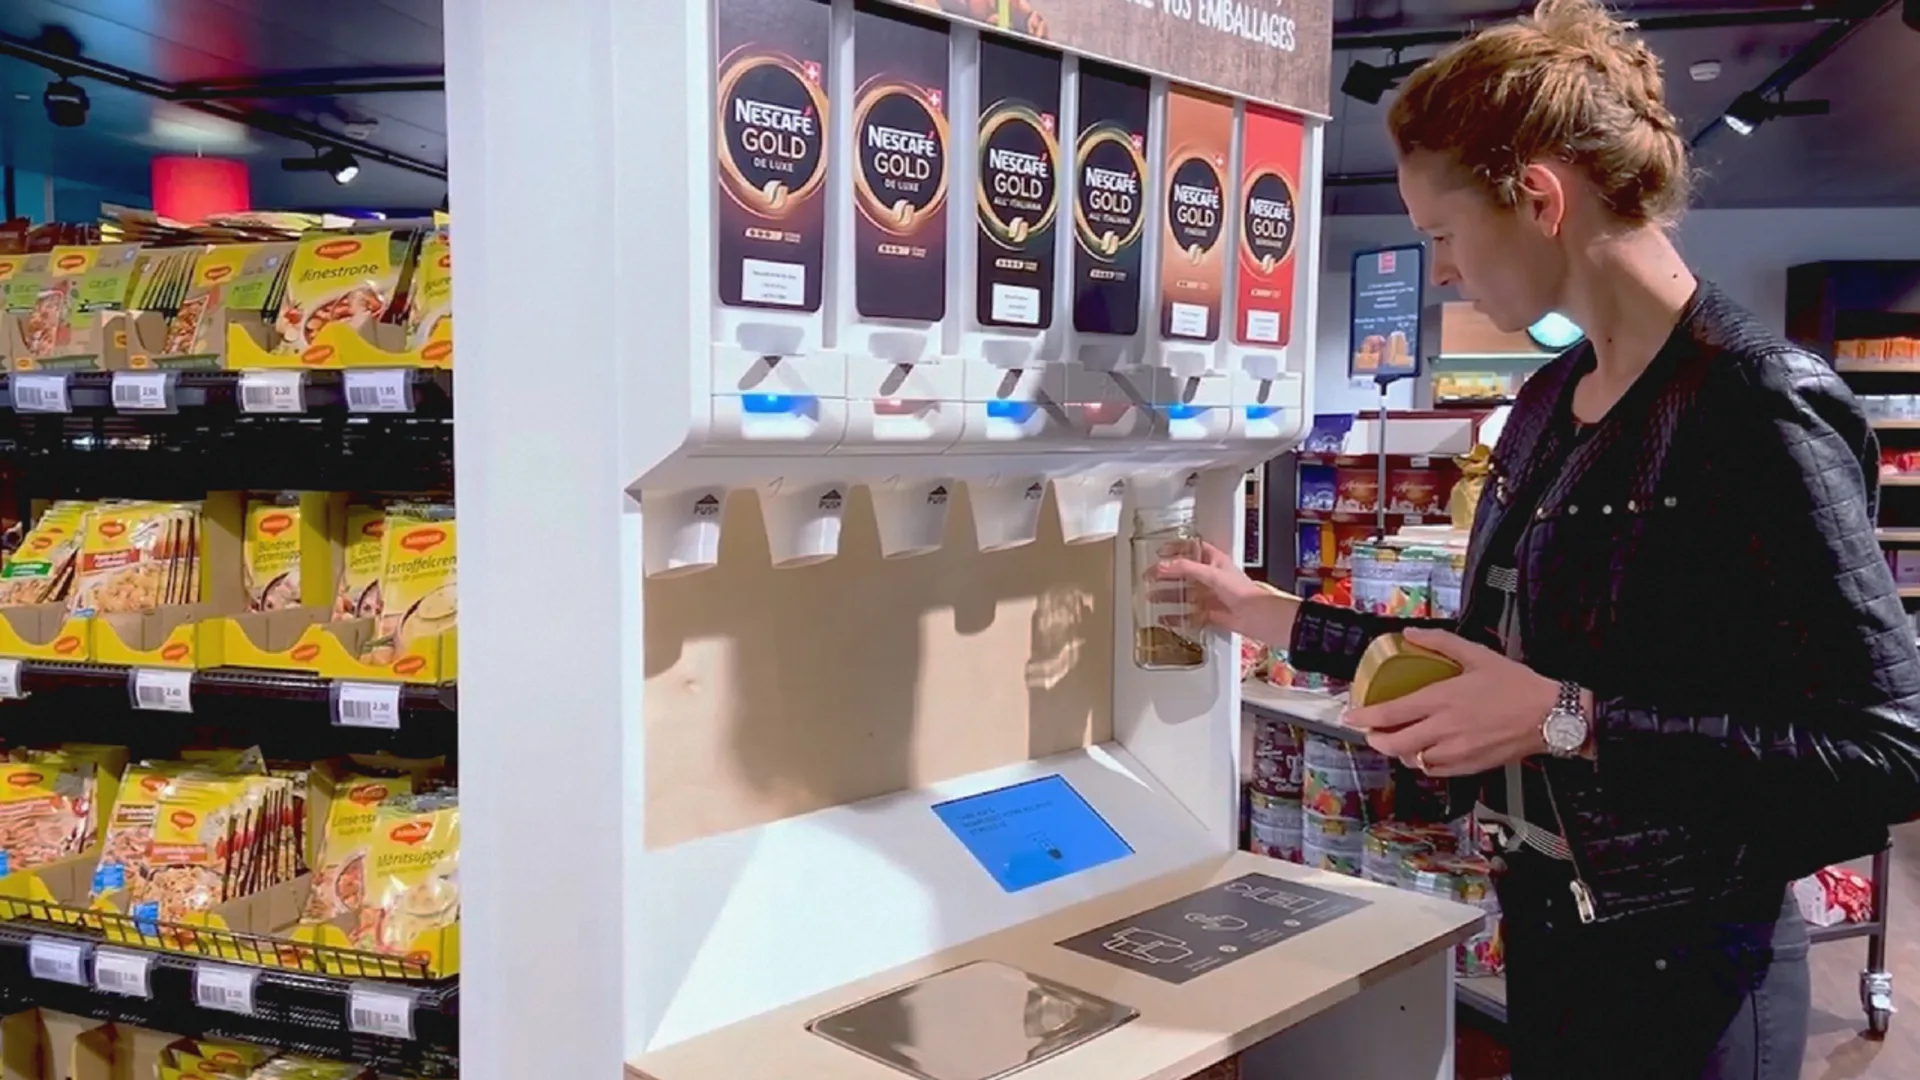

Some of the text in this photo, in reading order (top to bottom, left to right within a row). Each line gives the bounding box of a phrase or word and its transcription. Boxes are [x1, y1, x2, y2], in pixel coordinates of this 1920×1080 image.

[1198, 0, 1296, 52] EMBALLAGES
[735, 98, 815, 136] NESCAFÉ
[742, 127, 807, 159] GOLD
[867, 124, 938, 158] NESCAFÉ
[753, 157, 794, 173] DE LUXE
[874, 151, 931, 180] GOLD
[989, 148, 1049, 178] NESCAFÉ
[994, 172, 1044, 199] GOLD
[1085, 166, 1138, 194] NESCAFÉ
[1089, 190, 1133, 214] GOLD
[1174, 183, 1220, 209] NESCAFÉ
[1176, 205, 1216, 228] GOLD
[1249, 197, 1292, 222] NESCAFÉ
[1252, 218, 1287, 238] GOLD
[694, 504, 719, 516] PUSH
[818, 500, 842, 510] PUSH
